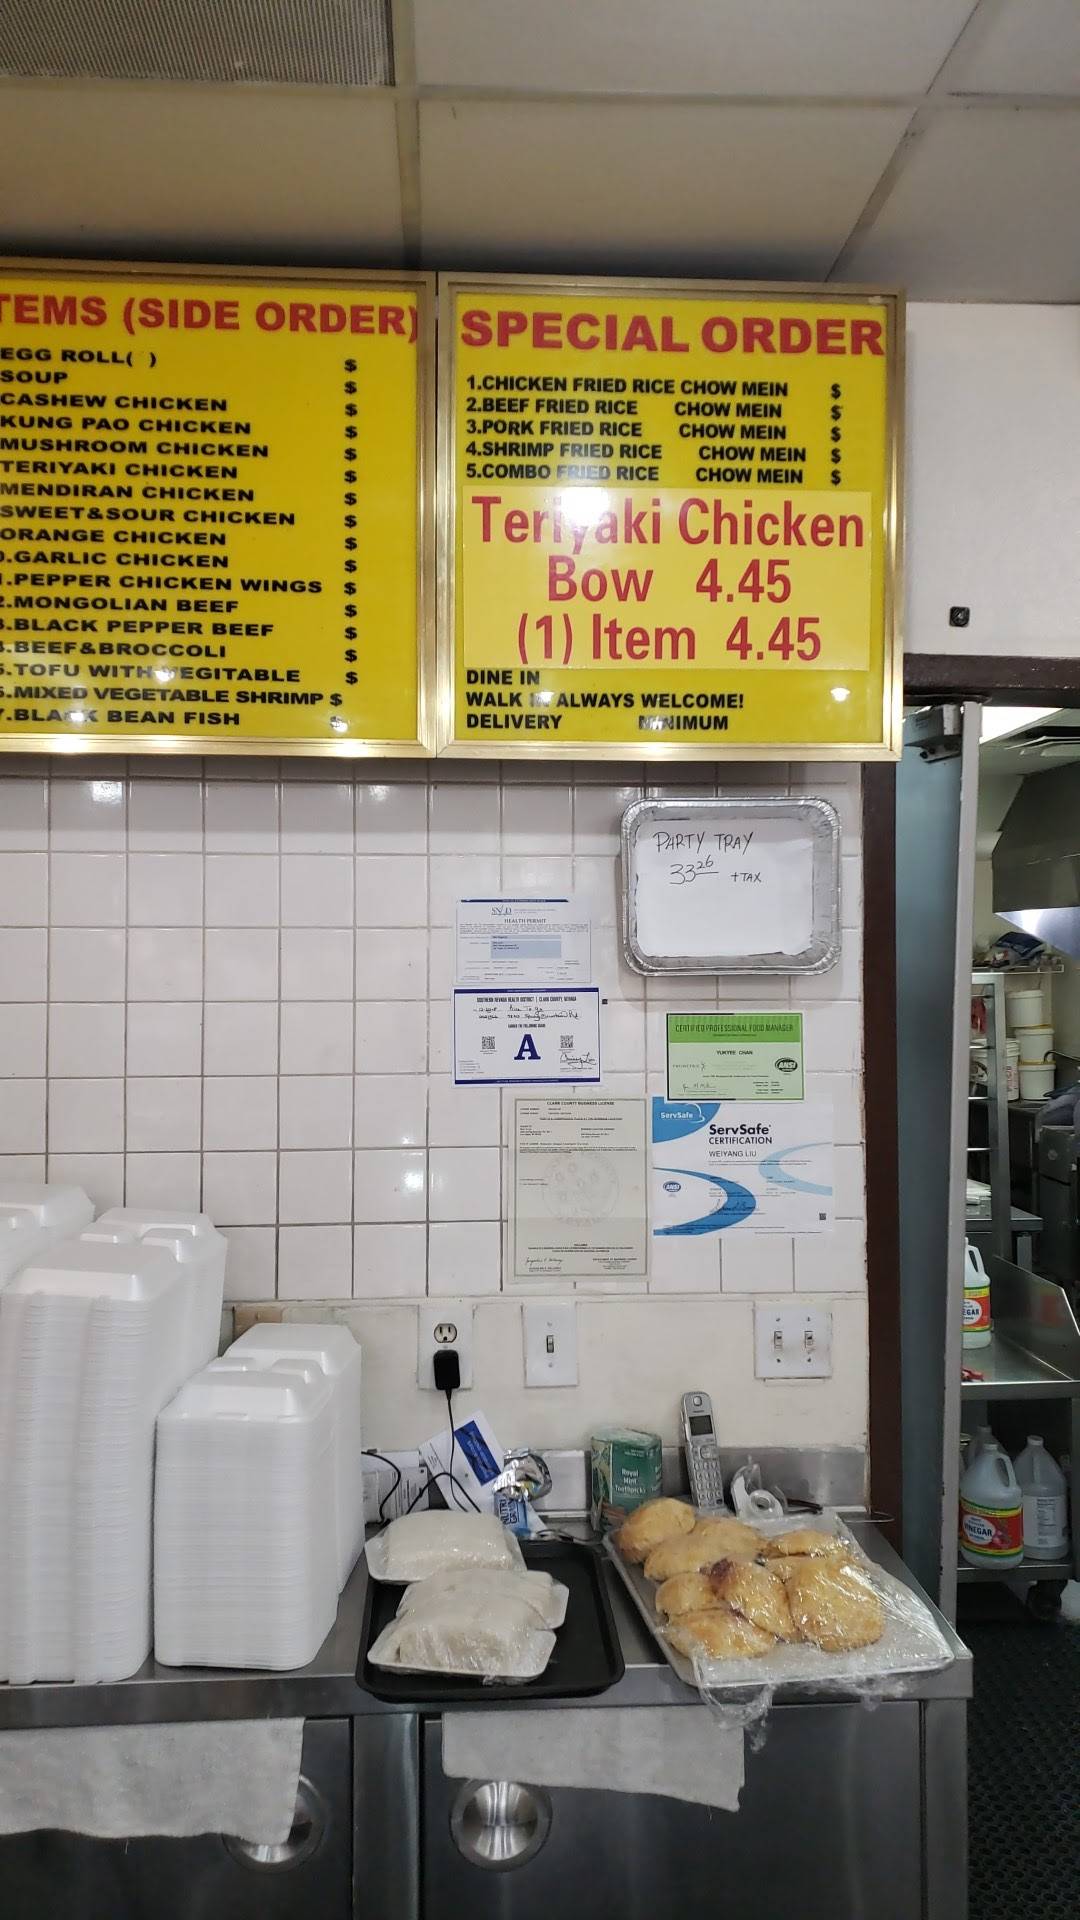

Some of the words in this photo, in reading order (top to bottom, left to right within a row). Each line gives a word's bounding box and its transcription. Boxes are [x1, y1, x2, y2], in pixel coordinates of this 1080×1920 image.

[122, 297, 240, 336] (SIDE
[255, 301, 417, 343] ORDER)
[461, 310, 689, 352] SPECIAL
[701, 315, 885, 356] ORDER
[344, 359, 357, 373] $
[0, 369, 68, 385] SOUP
[344, 381, 357, 395] $
[467, 375, 567, 392] 1.CHICKEN
[573, 378, 627, 393] FRIED
[633, 379, 675, 394] RICE
[681, 380, 737, 395] CHOW
[742, 381, 788, 397] MEIN
[831, 383, 841, 400] $
[0, 392, 107, 408] CASHEW
[114, 396, 227, 412] CHICKEN
[345, 403, 358, 417] $
[466, 397, 529, 413] 2.BEEF
[536, 399, 589, 414] FRIED
[595, 400, 638, 415] RICE
[675, 401, 731, 417] CHOW
[736, 403, 782, 418] MEIN
[831, 405, 842, 421] $
[0, 415, 73, 430] KUNG
[82, 417, 130, 432] PAO
[138, 419, 251, 435] CHICKEN
[345, 425, 358, 439] $
[467, 419, 534, 436] 3.PORK
[540, 421, 593, 435] FRIED
[600, 422, 642, 437] RICE
[679, 423, 735, 439] CHOW
[741, 424, 786, 440] MEIN
[831, 426, 841, 443] $
[0, 438, 147, 454] MUSHROOM
[156, 442, 268, 458] CHICKEN
[344, 448, 357, 462] $
[466, 441, 554, 457] 4.SHRIMP
[560, 443, 614, 457] FRIED
[620, 444, 662, 459] RICE
[699, 446, 755, 461] CHOW
[760, 447, 806, 462] MEIN
[831, 448, 841, 464] $
[0, 460, 116, 476] TERIYAKI
[125, 463, 237, 479] CHICKEN
[344, 470, 357, 484] $
[467, 463, 550, 479] 5.COMBO
[557, 464, 610, 479] FRIED
[617, 466, 658, 481] RICE
[696, 467, 752, 482] CHOW
[757, 468, 803, 484] MEIN
[831, 469, 841, 486] $
[0, 483, 132, 498] MENDIRAN
[142, 486, 254, 502] CHICKEN
[344, 492, 357, 506] $
[0, 505, 175, 522] SWEET&SOUR
[183, 510, 295, 525] CHICKEN
[344, 515, 357, 529] $
[678, 499, 864, 547] Chicken
[0, 528, 104, 543] ORANGE
[113, 530, 226, 546] CHICKEN
[345, 537, 357, 551] $
[0, 550, 107, 565] .GARLIC
[116, 553, 228, 568] CHICKEN
[345, 559, 357, 573] $
[0, 573, 111, 588] .PEPPER
[119, 575, 231, 590] CHICKEN
[240, 579, 322, 593] WINGS
[548, 555, 653, 601] Bow
[696, 559, 792, 604] 4.45
[344, 582, 356, 596] $
[177, 600, 238, 613] BEEF
[345, 604, 357, 618] $
[107, 620, 203, 635] PEPPER
[212, 623, 273, 636] BEEF
[345, 627, 357, 640] $
[518, 613, 573, 665] (1)
[593, 614, 696, 660] Item
[726, 617, 821, 661] 4.45
[345, 649, 357, 663] $
[89, 665, 153, 679] WITH
[345, 671, 358, 685] $
[467, 669, 512, 685] DINE
[520, 671, 540, 685] IN
[95, 687, 230, 704] VEGETABLE
[236, 691, 323, 705] SHRIMP
[330, 693, 342, 706] $
[466, 692, 522, 707] WALK
[557, 693, 634, 708] ALWAYS
[641, 694, 743, 708] WELCOME!
[107, 710, 174, 724] BEAN
[184, 712, 239, 725] FISH
[467, 714, 562, 729] DELIVERY
[653, 831, 705, 853] PARTY
[714, 831, 754, 855] TRAY
[514, 1034, 541, 1060] A
[709, 1124, 769, 1135] ServSafe
[709, 1137, 772, 1145] CERTIFICATION
